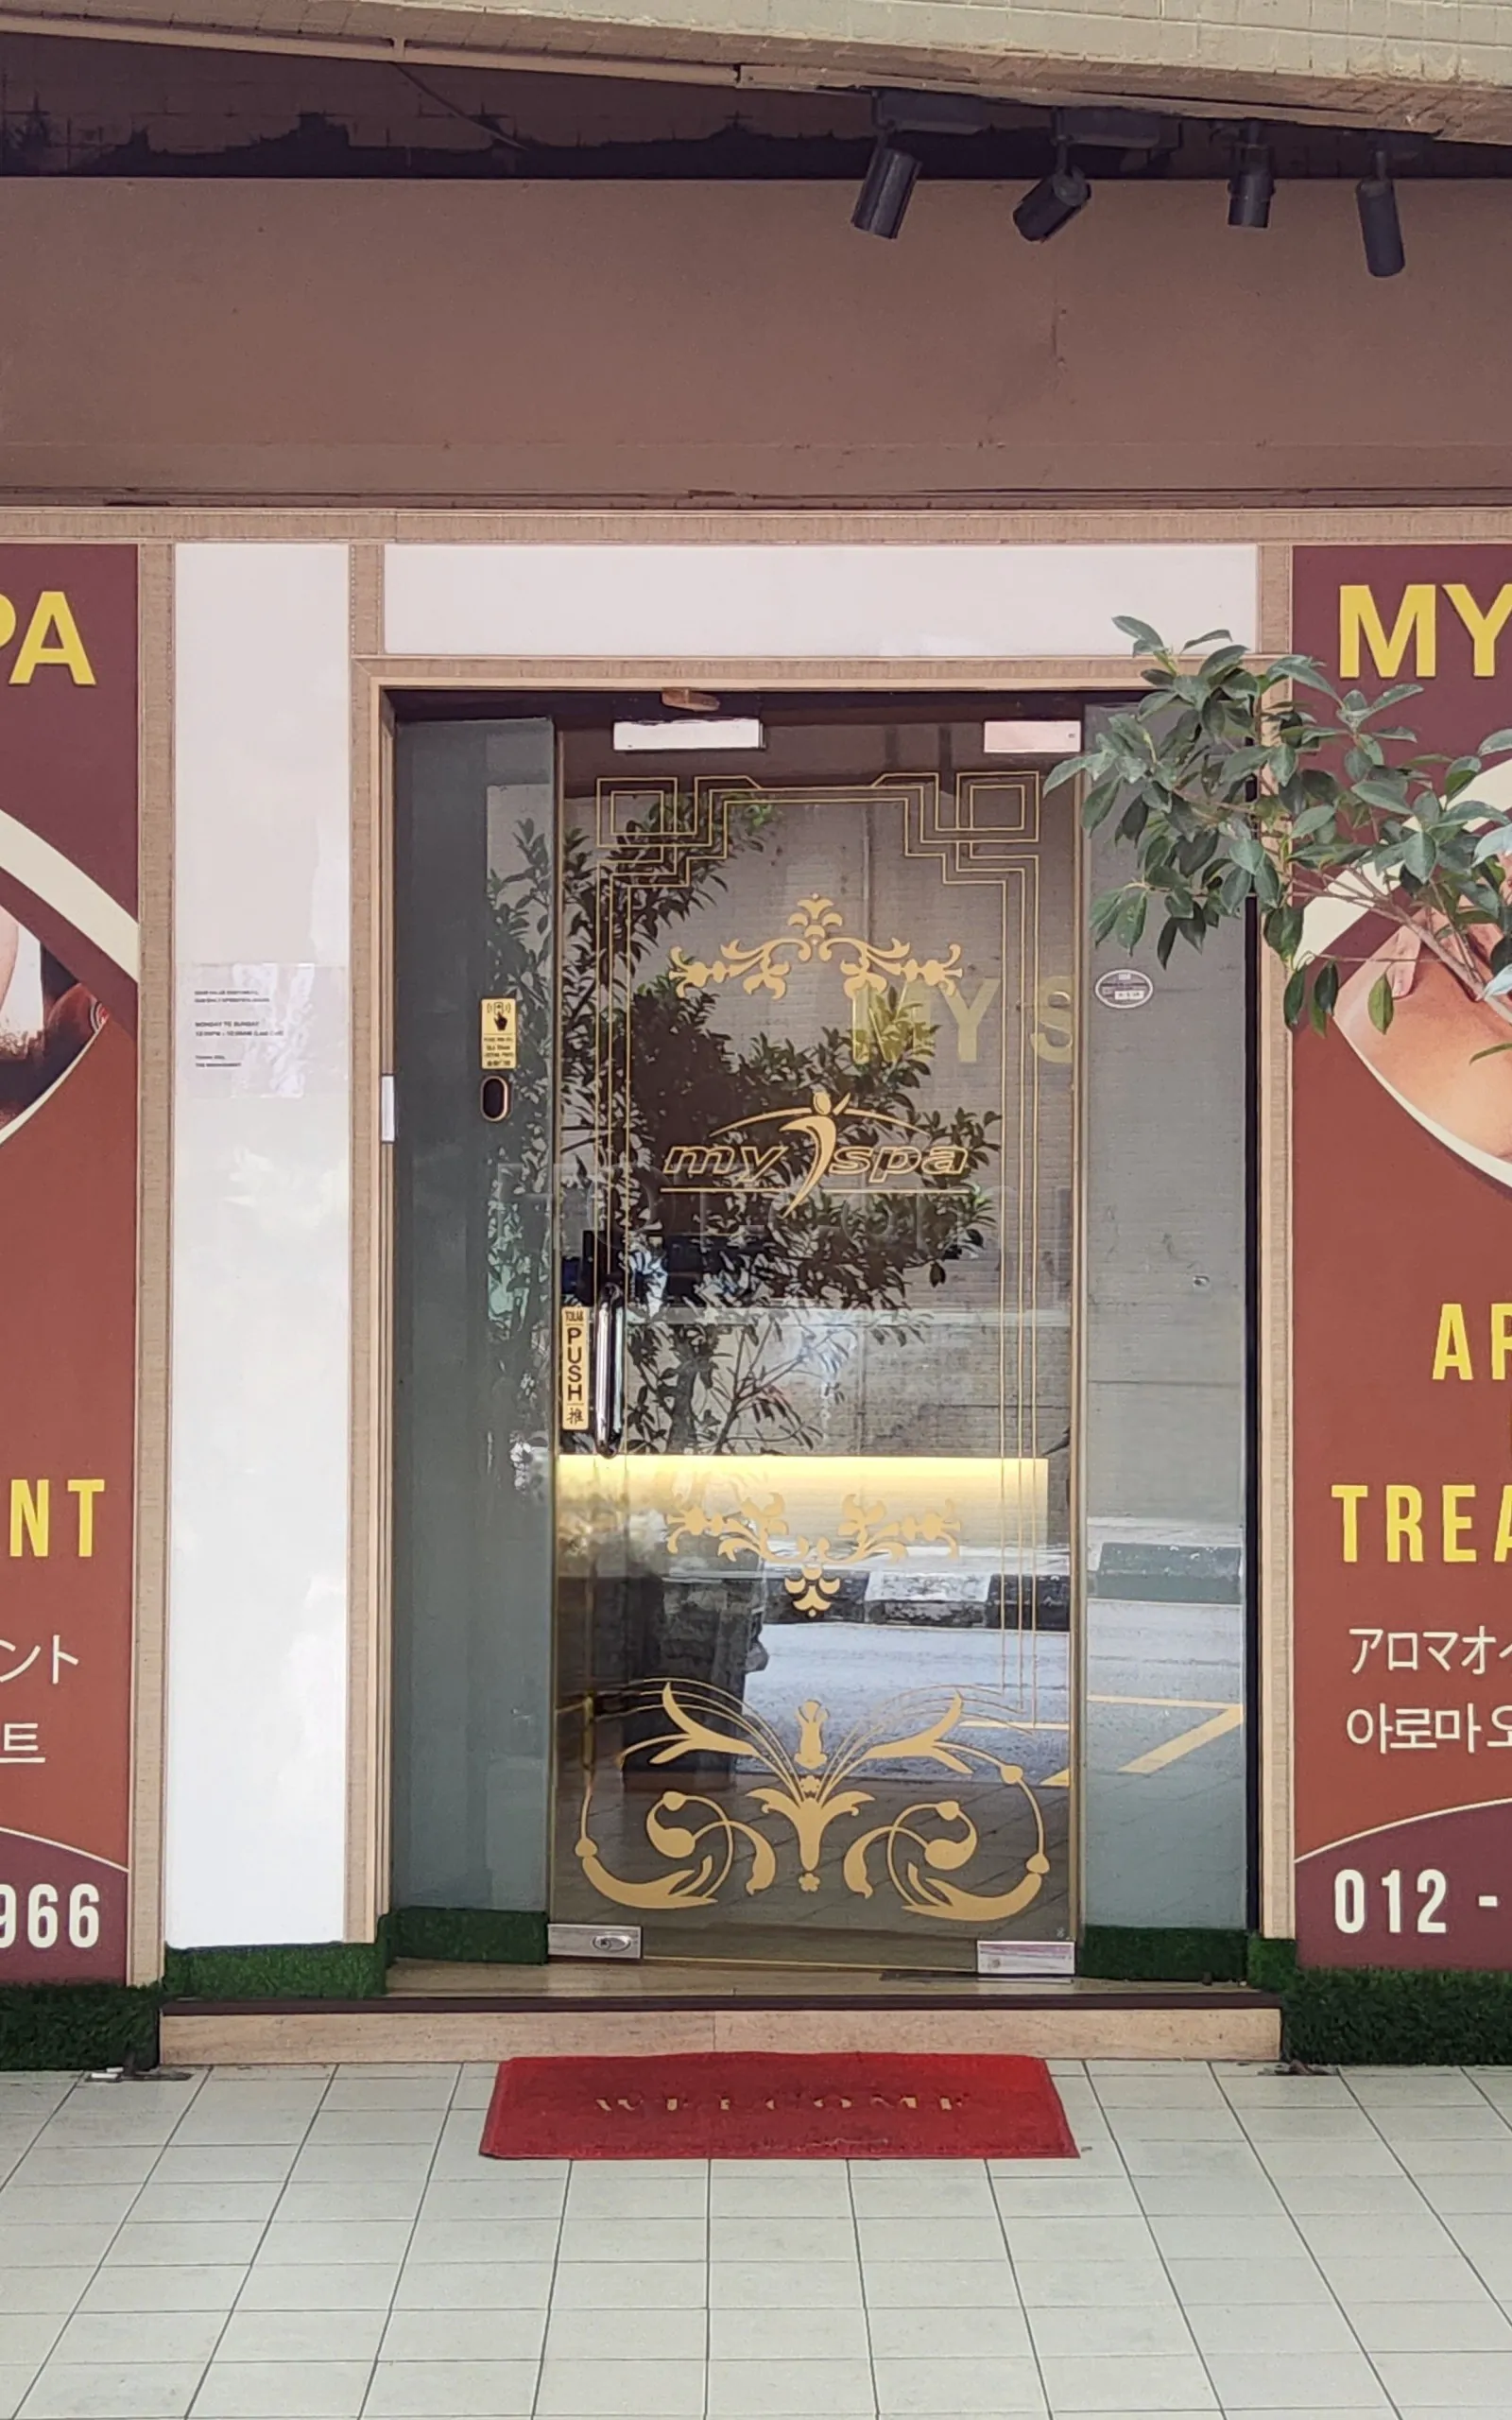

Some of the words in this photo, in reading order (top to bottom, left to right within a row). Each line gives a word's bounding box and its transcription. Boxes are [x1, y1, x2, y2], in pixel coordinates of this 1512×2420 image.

[0, 590, 96, 684] A
[1340, 583, 1512, 678] MY
[663, 1146, 787, 1183] my
[829, 1146, 968, 1183] spa
[567, 1326, 582, 1401] PUSH
[9, 1479, 105, 1557] NT
[1334, 1869, 1447, 1934] 012
